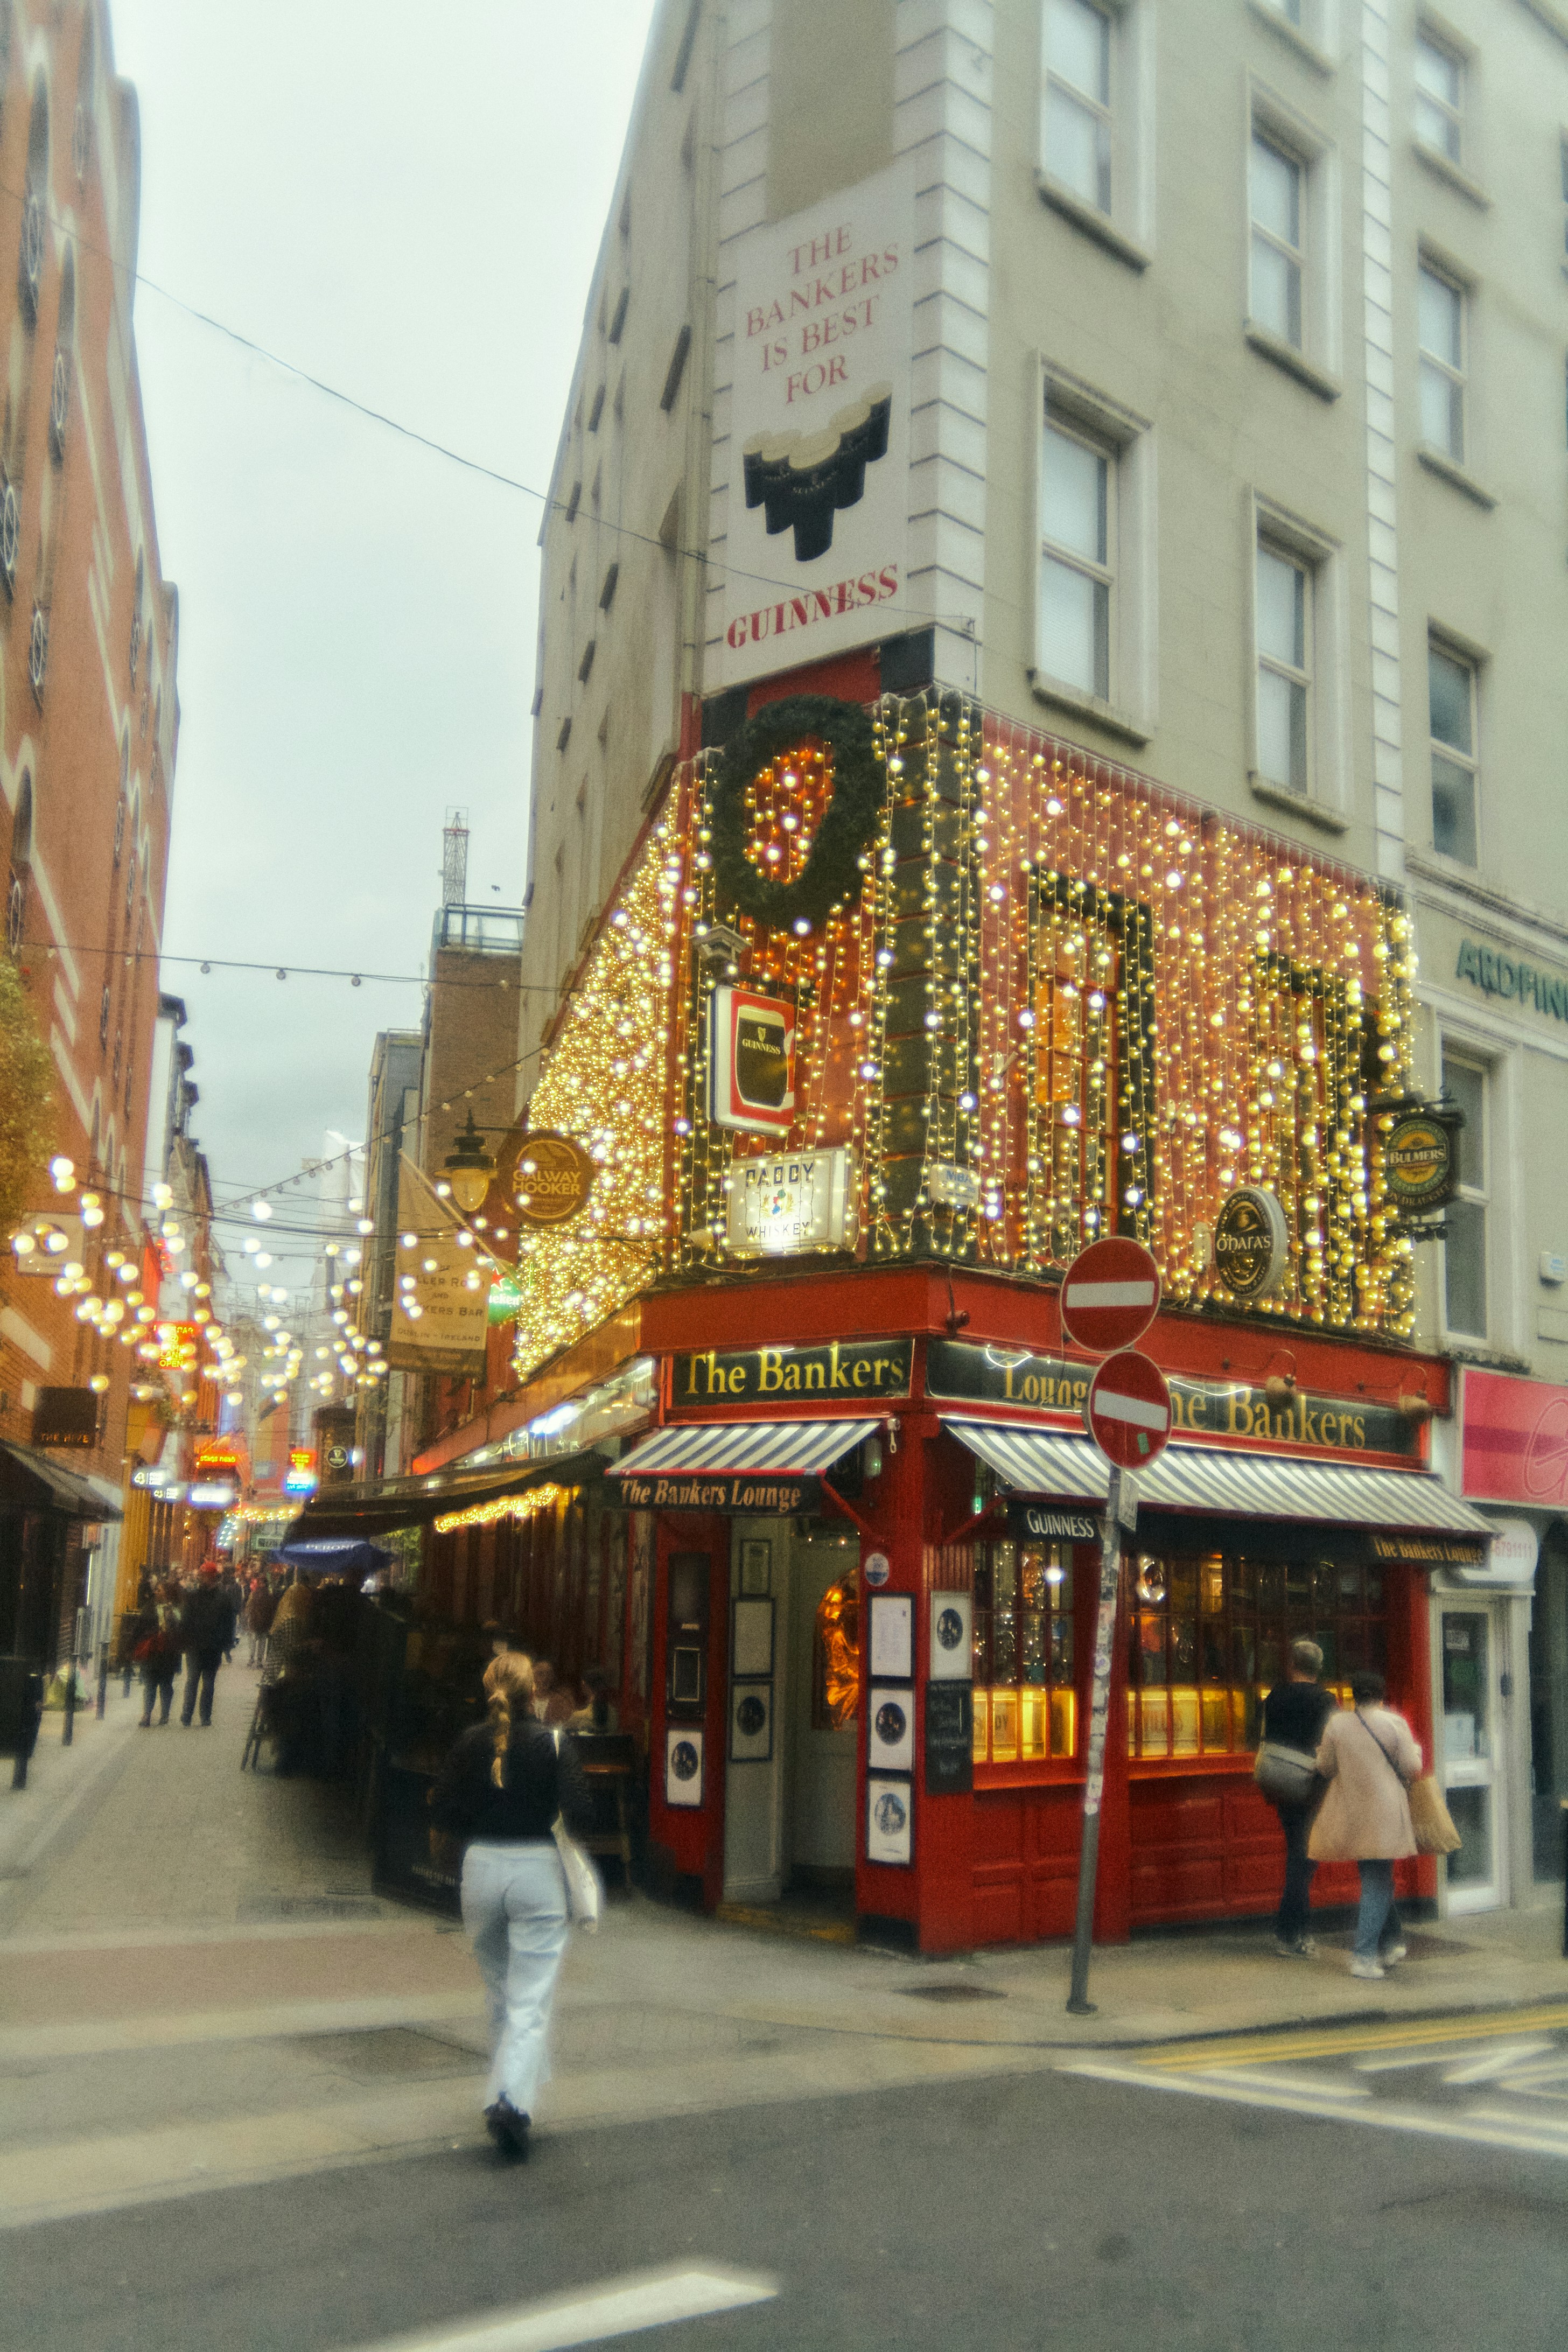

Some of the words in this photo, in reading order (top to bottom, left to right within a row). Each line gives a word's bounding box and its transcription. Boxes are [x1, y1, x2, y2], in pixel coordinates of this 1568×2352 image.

[788, 222, 853, 275] THE
[745, 242, 900, 339] BANKERS
[762, 335, 787, 372] IS
[801, 295, 880, 354] BEST
[786, 354, 849, 404] FOR
[727, 563, 898, 649] GUINNESS
[742, 1038, 781, 1055] GUINNESS
[1390, 1148, 1445, 1164] BULMERS
[513, 1169, 581, 1183] GALWAY
[513, 1180, 581, 1195] HOOKER
[746, 1162, 814, 1188] PADDY
[747, 1221, 810, 1238] WHISKEY
[440, 1333, 481, 1342] IRELAND
[685, 1349, 746, 1395] The
[757, 1341, 905, 1392] Bankers
[1005, 1361, 1088, 1408] Loung
[1227, 1385, 1366, 1450] Bankers
[620, 1479, 650, 1504] The
[653, 1478, 726, 1506] Bankers
[730, 1479, 802, 1513] Lounge
[1026, 1508, 1095, 1539] GUINNESS
[1373, 1536, 1398, 1558] The
